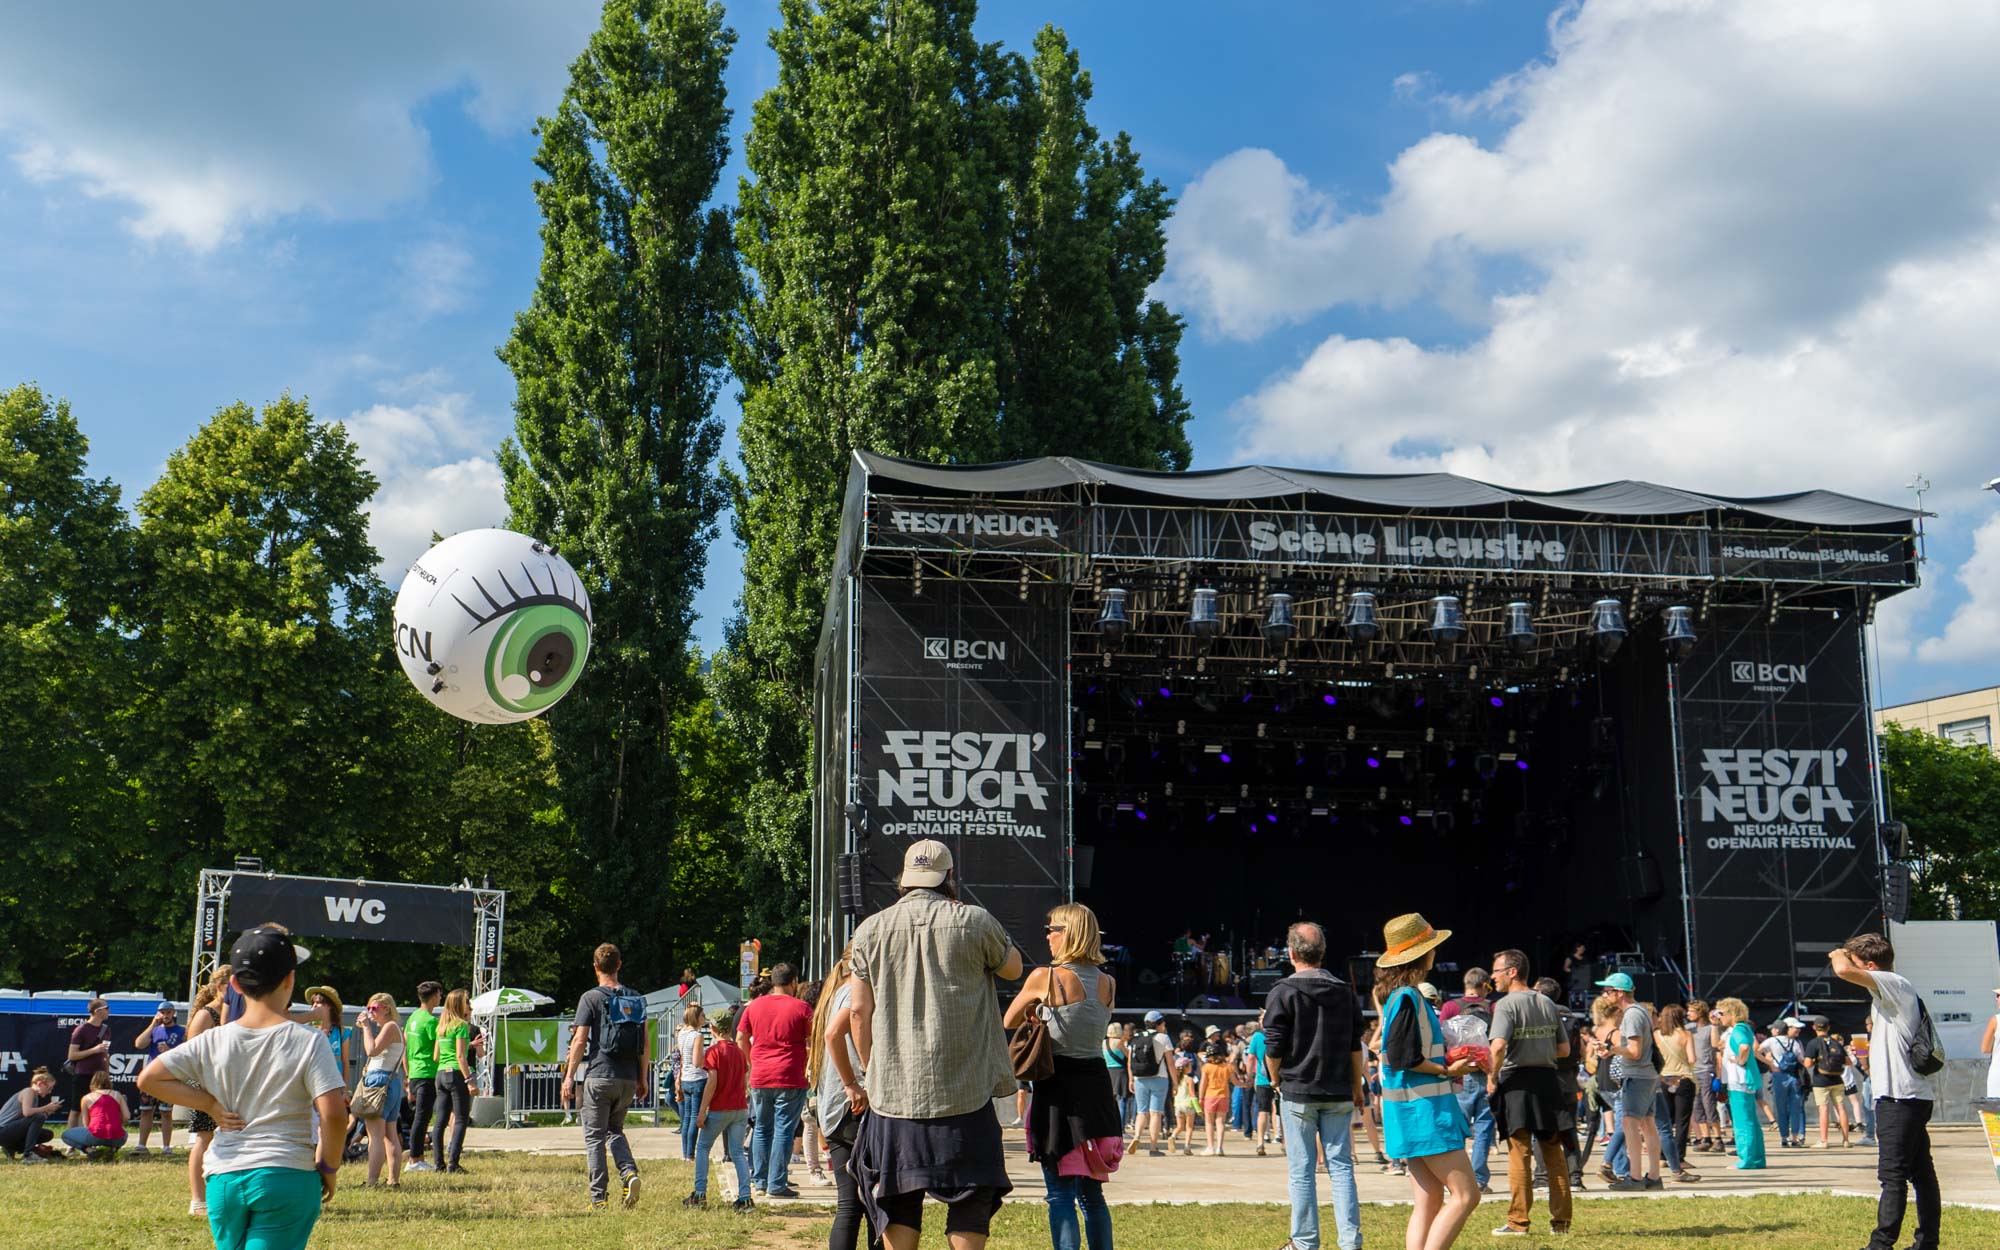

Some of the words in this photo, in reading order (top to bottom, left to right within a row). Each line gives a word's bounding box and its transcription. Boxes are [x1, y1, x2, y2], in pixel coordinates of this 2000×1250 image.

[1248, 521, 1376, 555] Scène
[1384, 526, 1565, 562] Lacustre
[1722, 546, 1889, 563] #SmallTownBigMusic
[953, 640, 1005, 660] BCN
[1758, 664, 1806, 683] BCN
[881, 731, 1046, 771] FESTI'
[1700, 748, 1848, 785] FESTI'
[878, 769, 1048, 810] NEUCH
[1701, 785, 1854, 822] NEUCH
[913, 808, 1016, 823] NEUCHÂTEL
[882, 822, 961, 836] OPENAIR
[965, 823, 1046, 838] FESTIVAL
[1734, 822, 1827, 836] NEUCHÂTEL
[1707, 837, 1778, 849] OPENAIR
[1782, 837, 1855, 849] FESTIVAL
[324, 896, 386, 925] WC
[204, 907, 214, 942] viteos
[487, 926, 496, 958] viteos
[500, 1004, 533, 1014] Heineken
[526, 1071, 562, 1079] NEUCHÂTE
